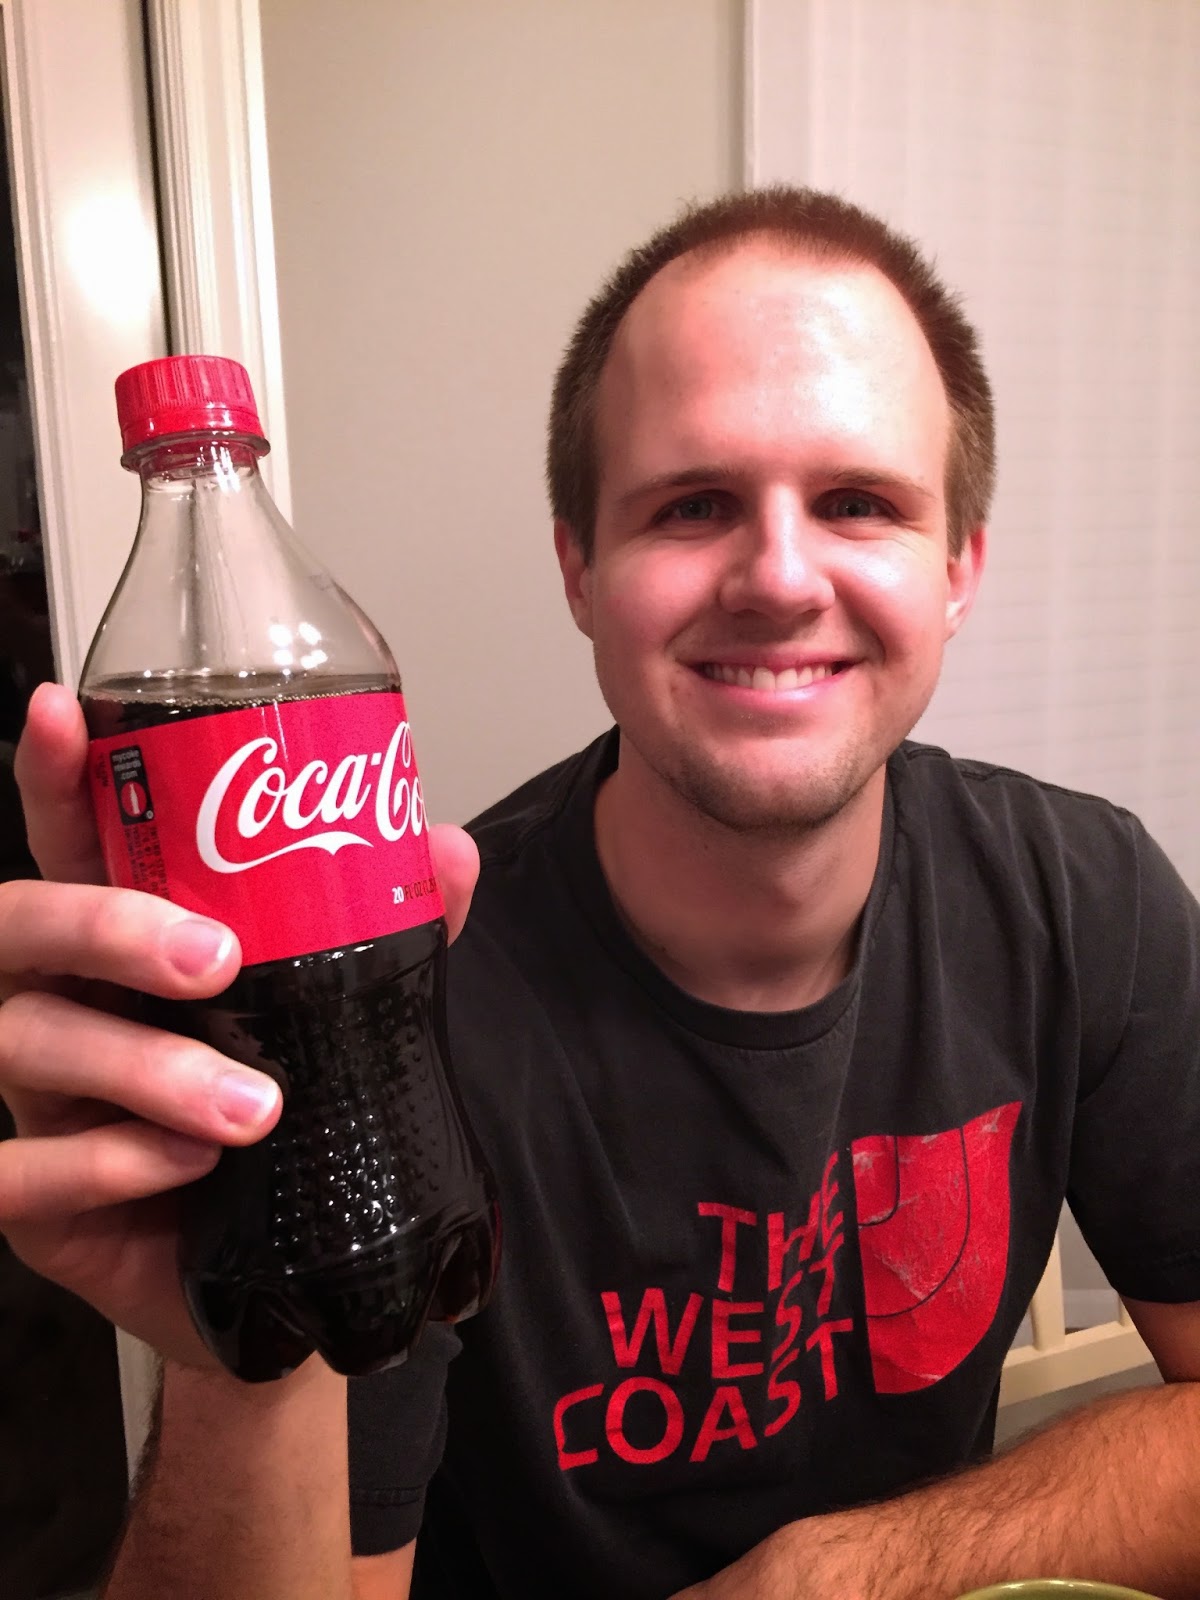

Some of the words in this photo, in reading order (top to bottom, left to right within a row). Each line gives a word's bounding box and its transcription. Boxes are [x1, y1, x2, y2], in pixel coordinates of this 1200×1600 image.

[391, 885, 405, 905] 20
[697, 1151, 845, 1293] THE
[600, 1232, 845, 1379] WEST
[552, 1317, 854, 1472] COAST
